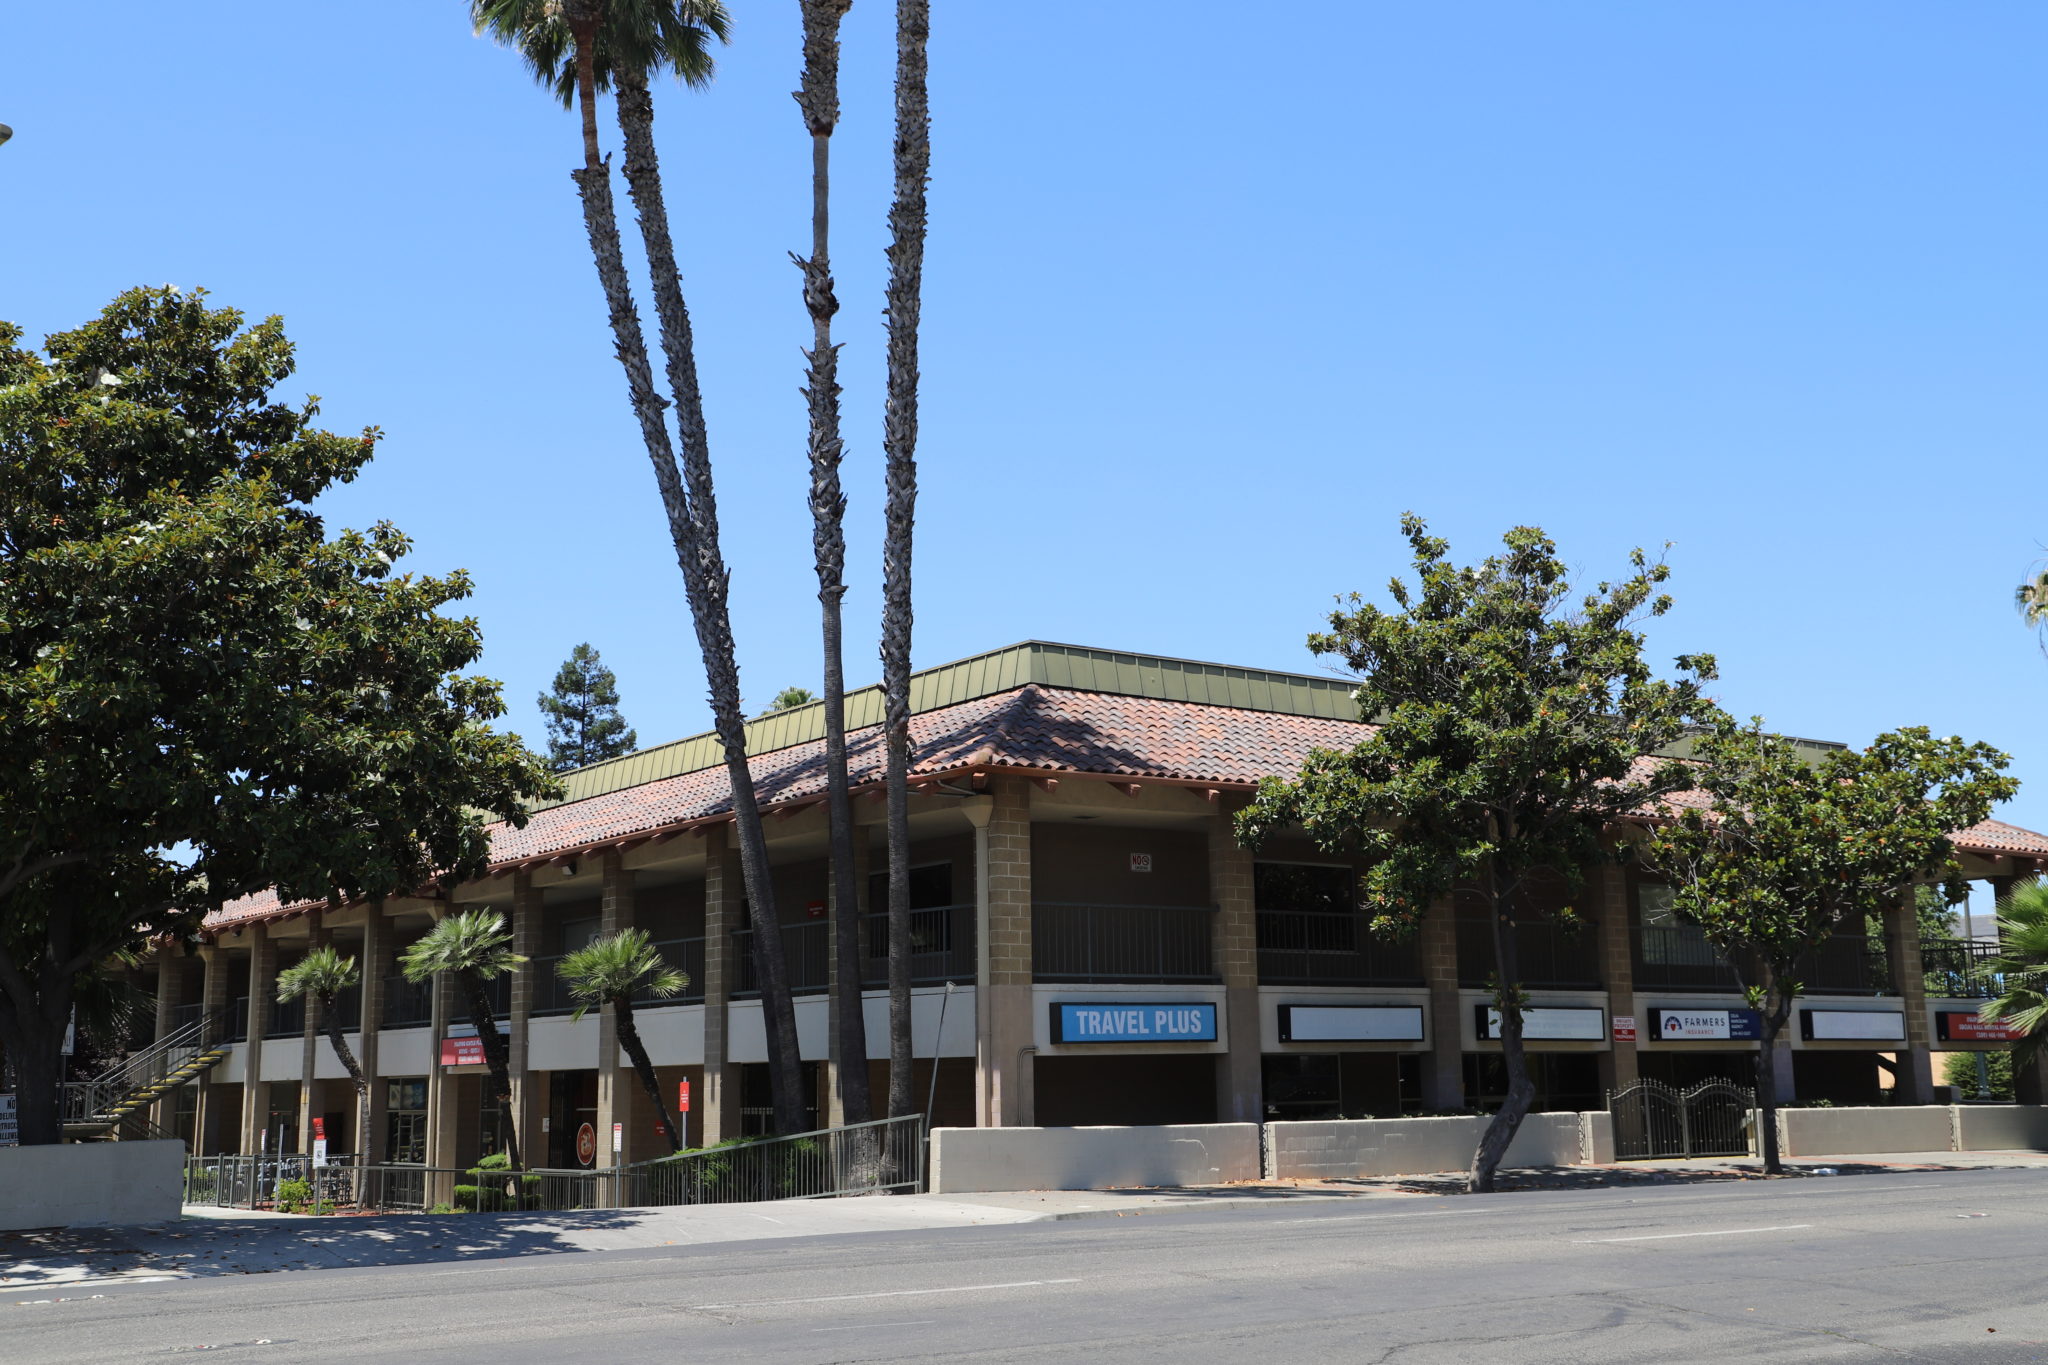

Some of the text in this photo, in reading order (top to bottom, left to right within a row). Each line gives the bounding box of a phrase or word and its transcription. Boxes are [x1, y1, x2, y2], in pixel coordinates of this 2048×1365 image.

[1076, 1009, 1202, 1035] TRAVEL PLUS
[1684, 1017, 1726, 1027] FARMERS
[7, 1099, 16, 1110] NO
[0, 1112, 17, 1120] DELIVE
[1, 1122, 17, 1130] TRUCK
